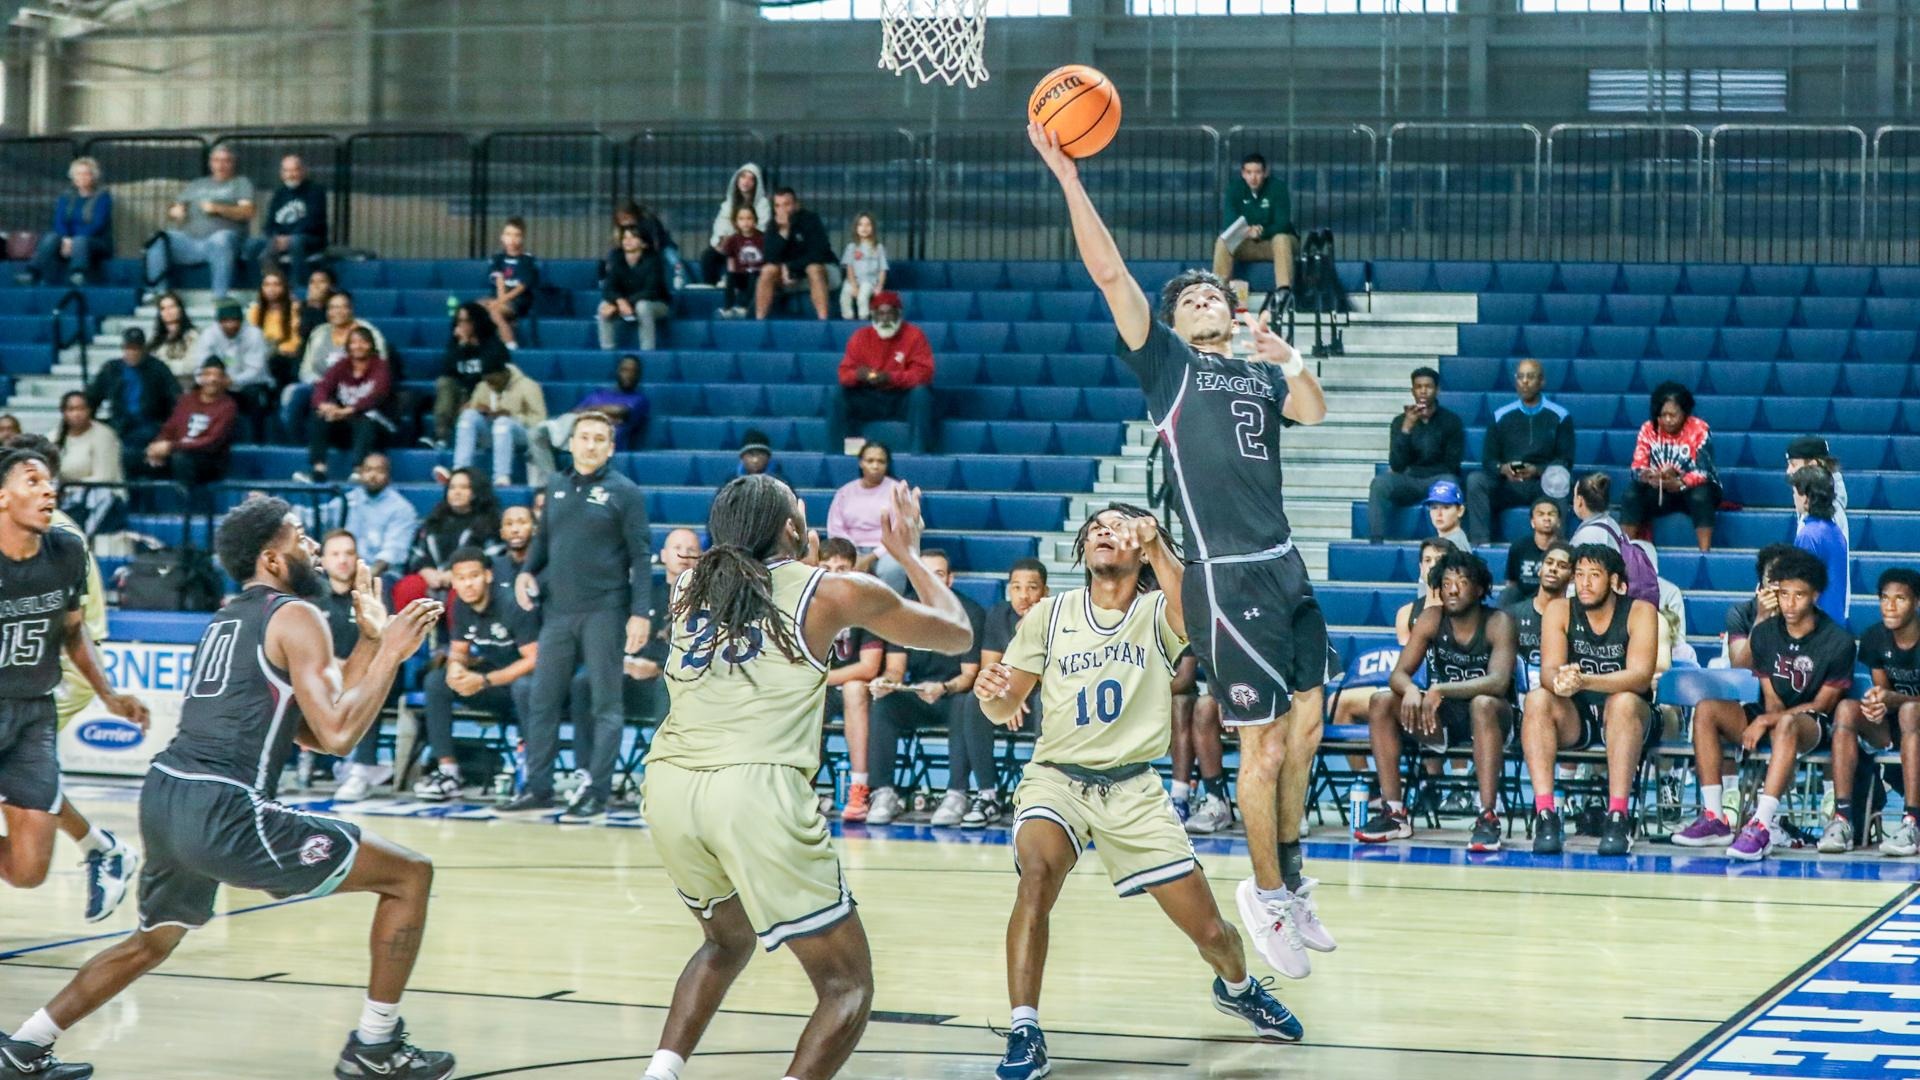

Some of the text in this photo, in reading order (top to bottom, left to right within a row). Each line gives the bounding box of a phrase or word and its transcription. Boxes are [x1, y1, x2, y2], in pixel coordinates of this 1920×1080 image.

[1033, 76, 1085, 116] Wilson
[1231, 400, 1269, 460] 2
[0, 589, 64, 618] AGLES
[0, 618, 50, 668] 15
[1058, 641, 1145, 676] WESLEYAN
[1358, 650, 1401, 676] CN
[1075, 679, 1124, 727] 10
[83, 723, 138, 743] Carrier
